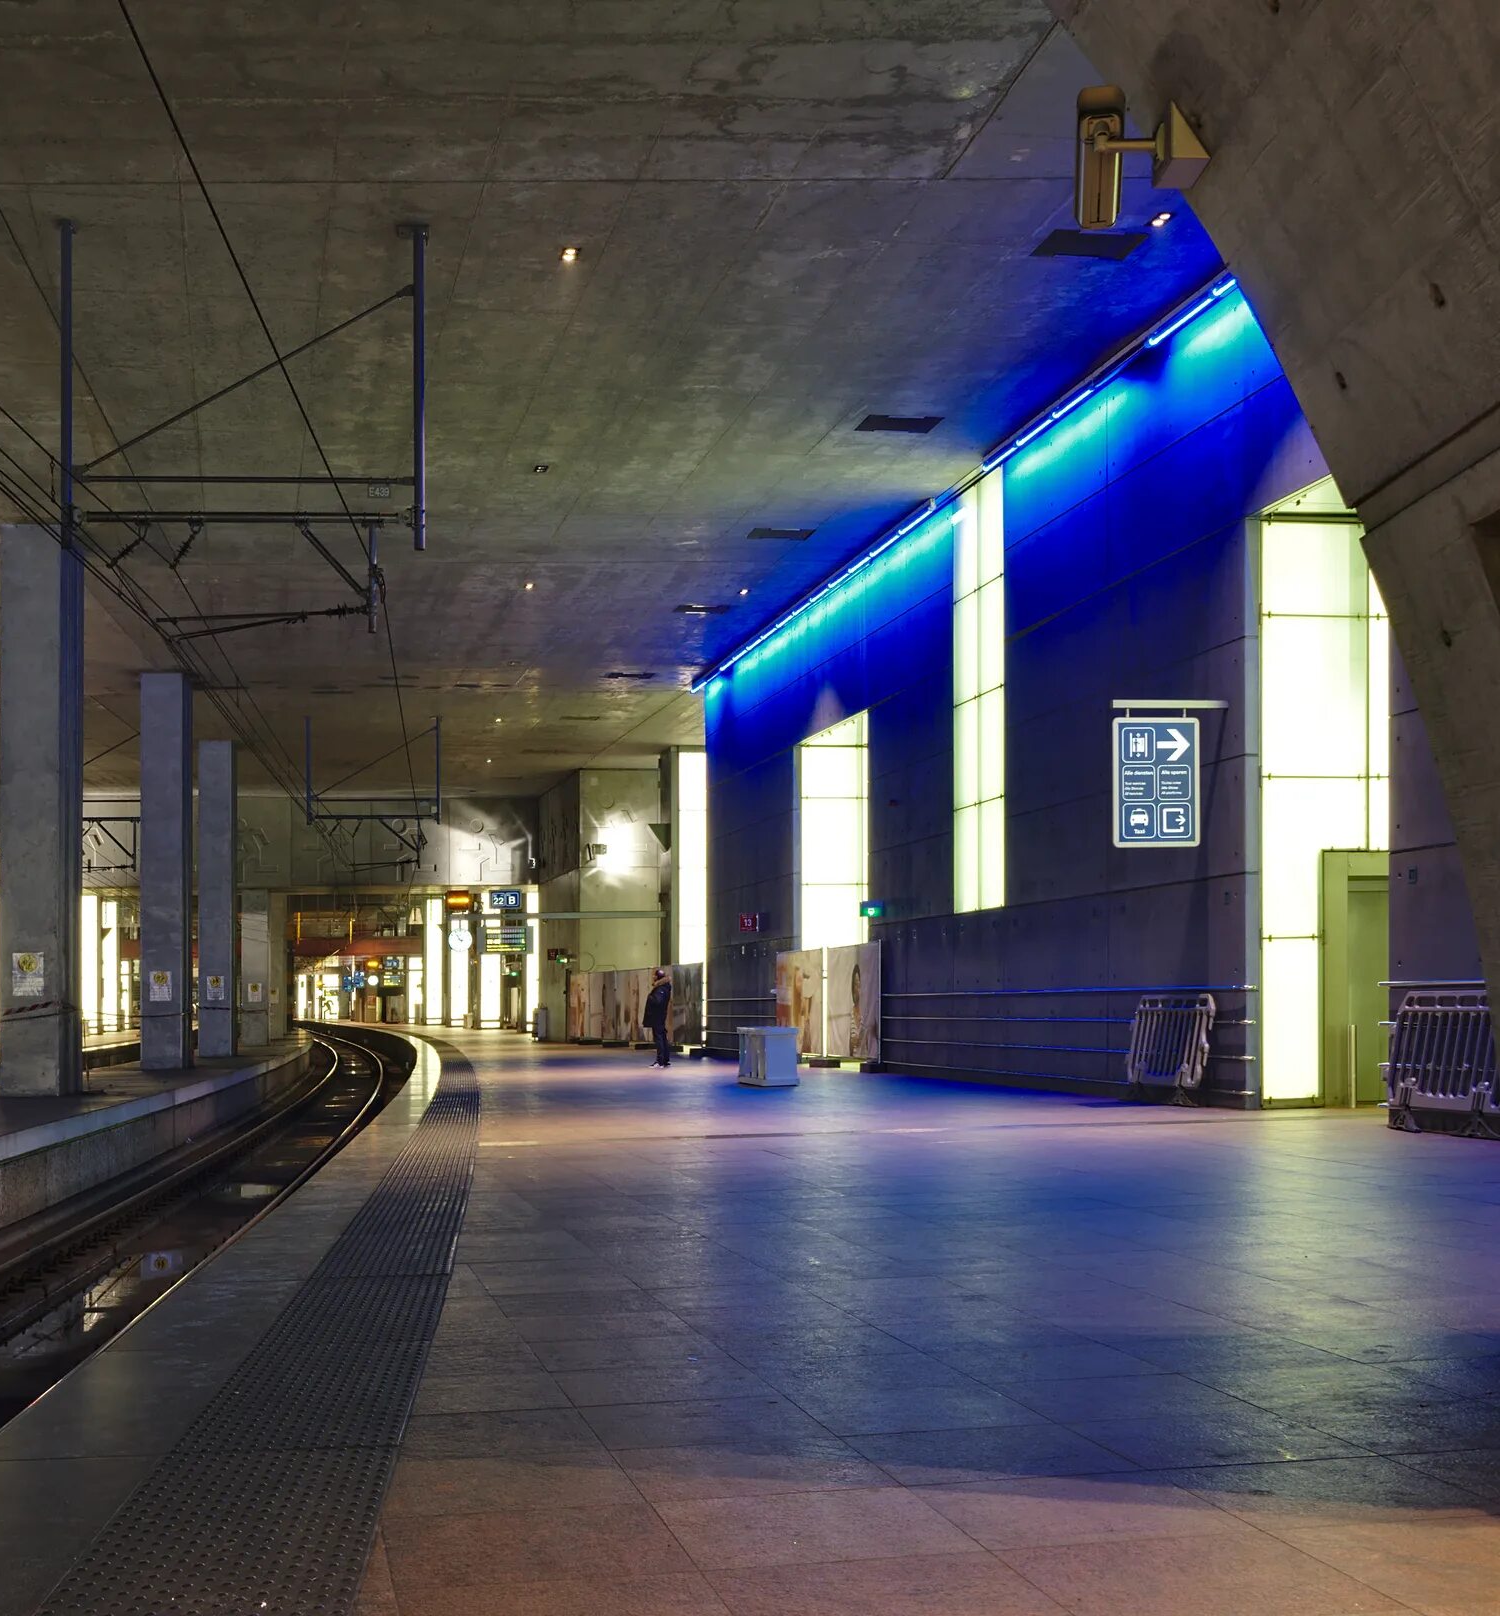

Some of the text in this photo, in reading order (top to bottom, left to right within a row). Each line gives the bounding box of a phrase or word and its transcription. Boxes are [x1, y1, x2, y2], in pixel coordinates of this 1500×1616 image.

[369, 487, 390, 497] E439
[493, 896, 516, 905] 22 B
[744, 918, 752, 927] 13
